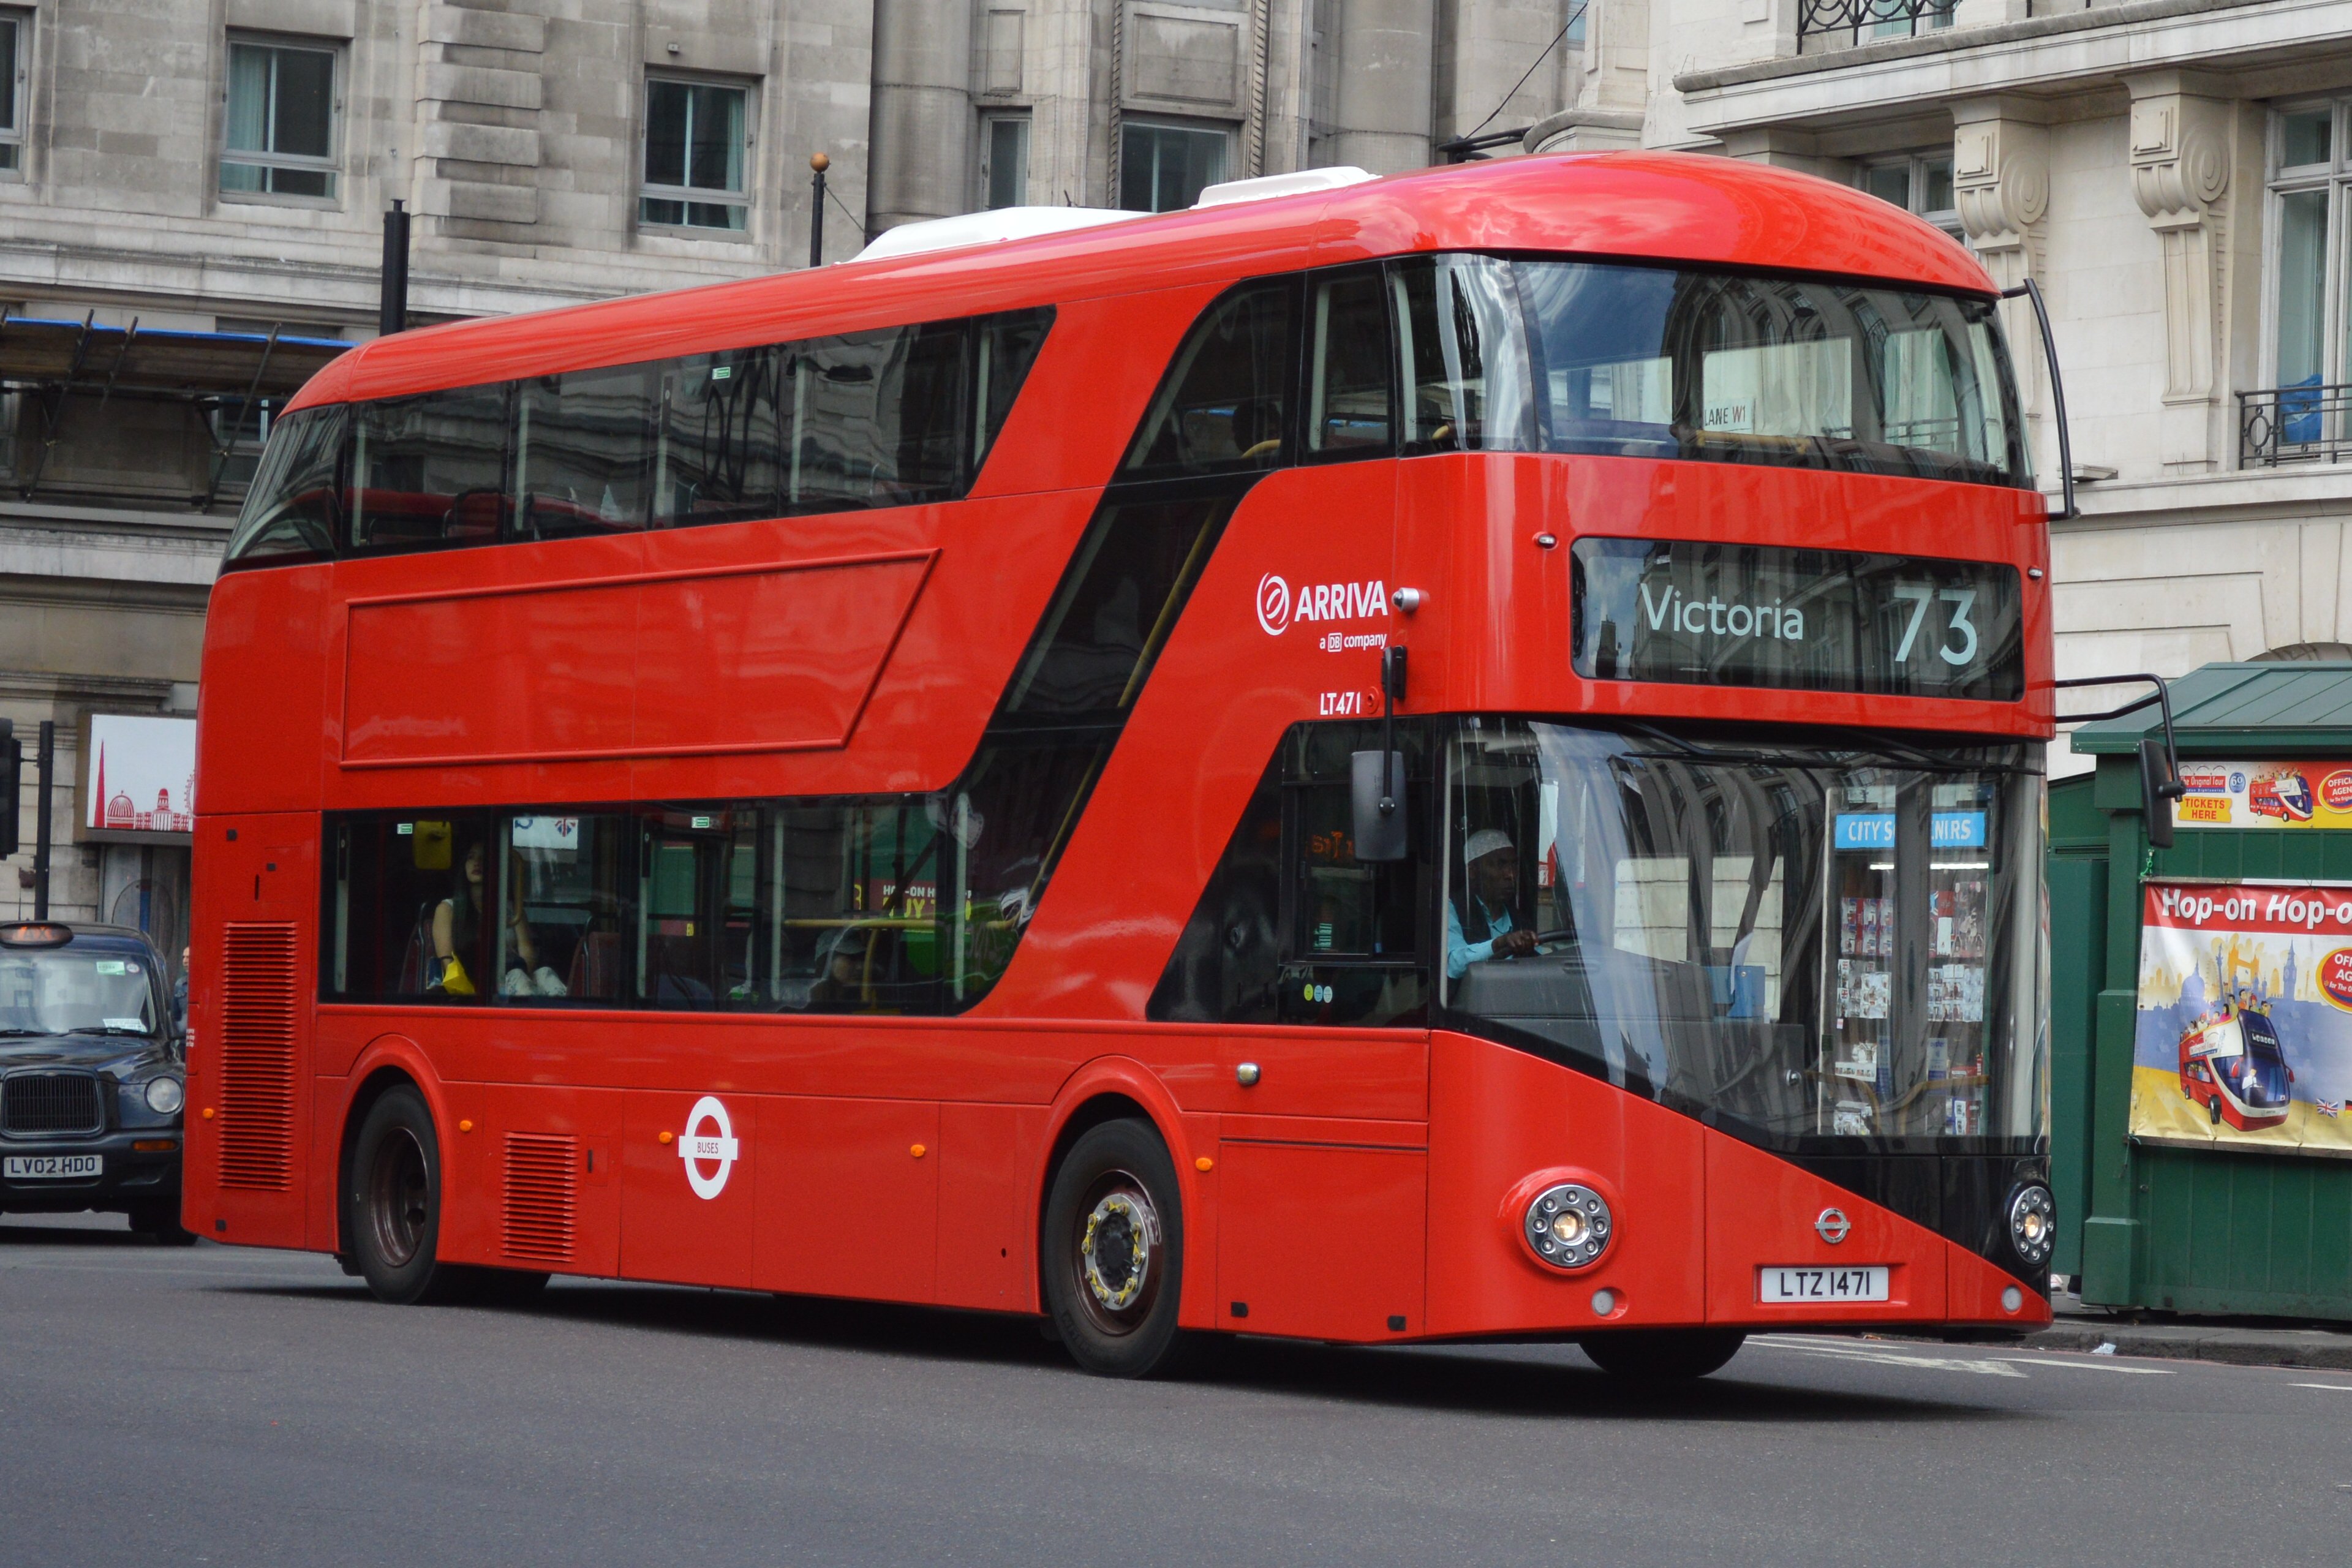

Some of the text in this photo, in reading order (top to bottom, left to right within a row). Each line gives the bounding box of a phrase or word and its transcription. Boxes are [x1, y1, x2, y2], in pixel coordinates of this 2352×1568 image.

[1705, 404, 1746, 426] LANE W1
[1294, 580, 1389, 622] ARRIVA
[1640, 582, 1979, 666] Victoria 73
[1319, 633, 1387, 651] a DB company
[1319, 692, 1361, 716] LT471
[2191, 775, 2212, 788] Original
[2212, 776, 2225, 785] Tour
[2231, 776, 2243, 786] 60
[2328, 777, 2352, 788] OFFICI
[2185, 798, 2225, 809] TICKETS
[2192, 809, 2217, 820] HERE
[1848, 821, 1882, 842] CITY
[2162, 888, 2257, 925] Hop-on
[2338, 982, 2347, 992] The
[697, 1142, 719, 1155] BUSES
[10, 1156, 96, 1174] LV02 HDO
[1781, 1271, 1870, 1296] LTZ 1471
